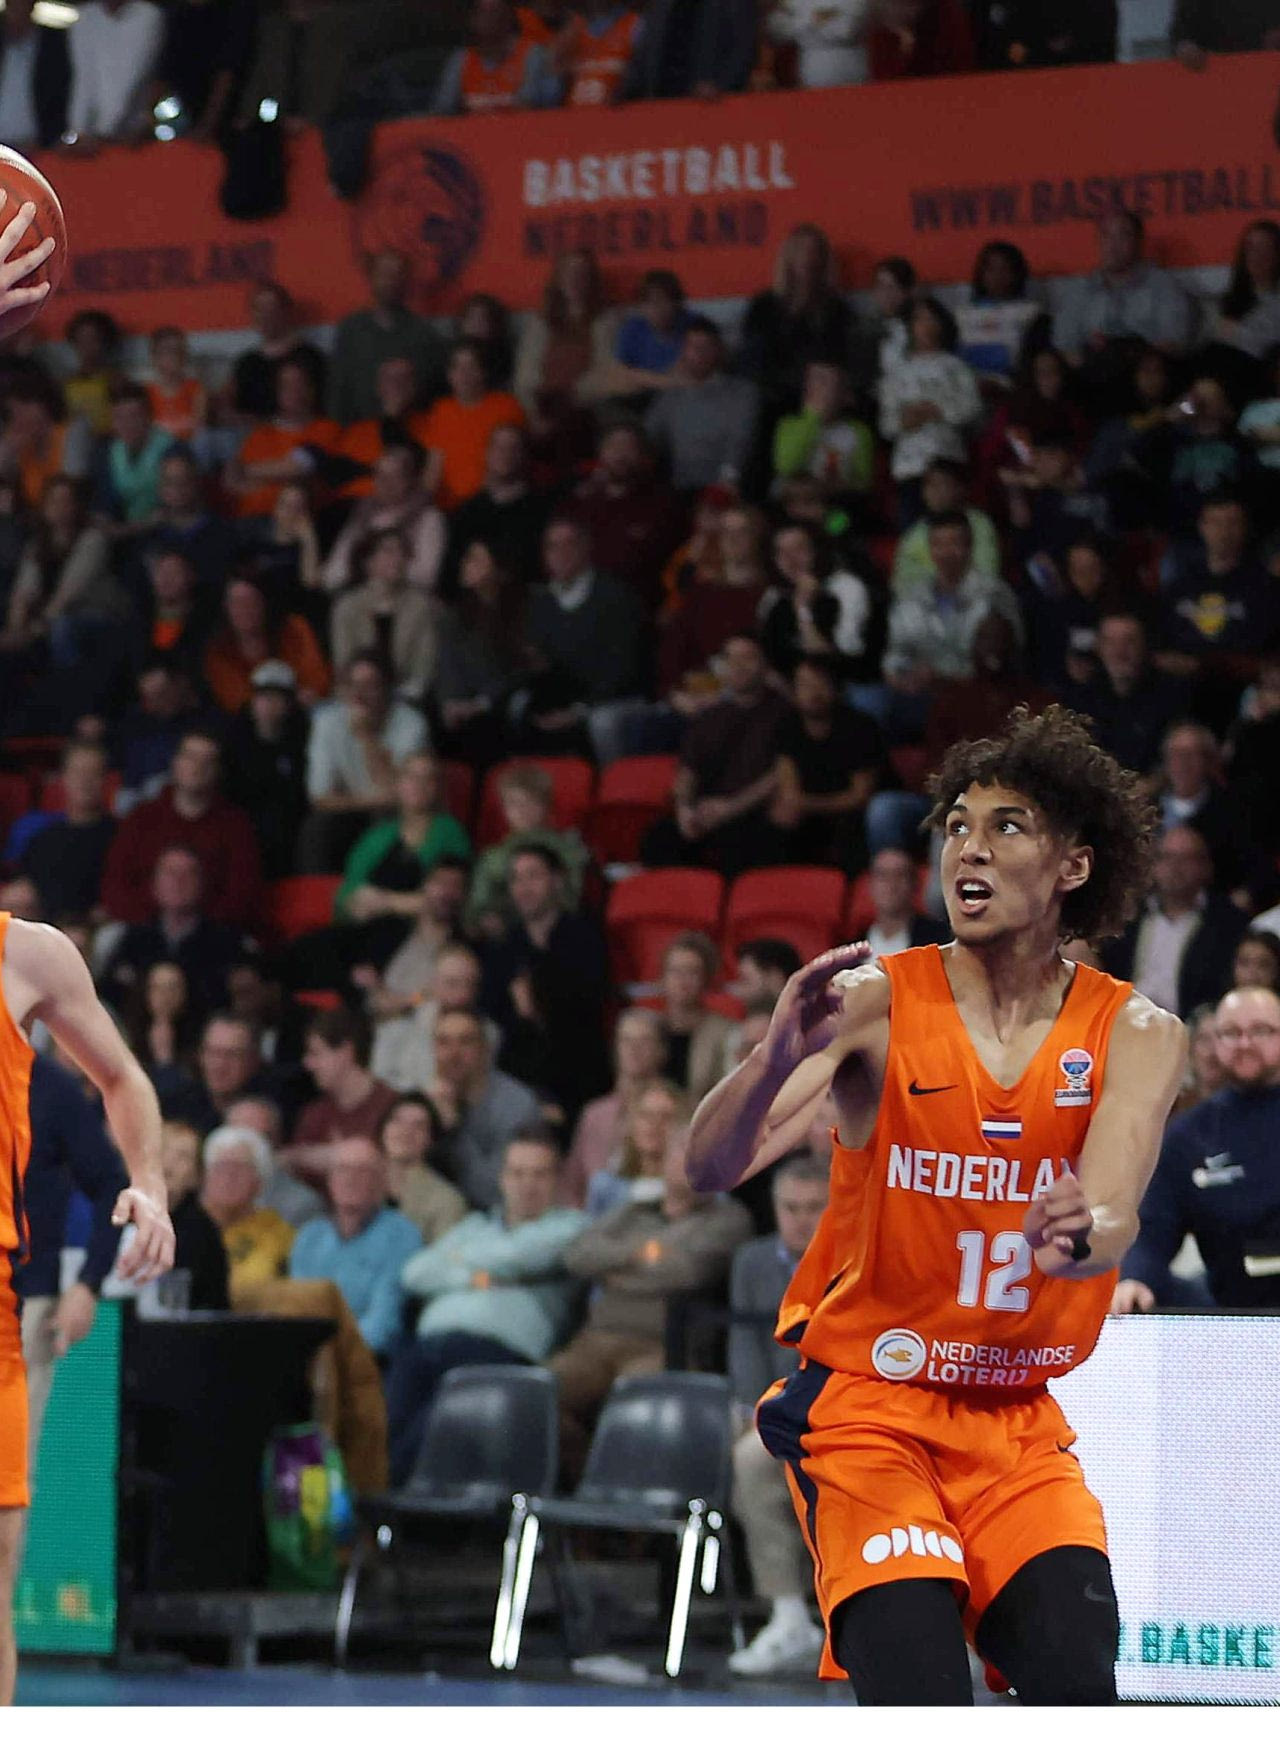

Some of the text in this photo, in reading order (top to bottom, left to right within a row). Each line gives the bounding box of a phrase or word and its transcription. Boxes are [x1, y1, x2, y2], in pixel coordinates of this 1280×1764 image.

[524, 139, 796, 207] BASKETBALL
[886, 1143, 1058, 1203] NEDERLA
[956, 1230, 1032, 1312] 12
[930, 1339, 1076, 1367] NEDERLANDSE
